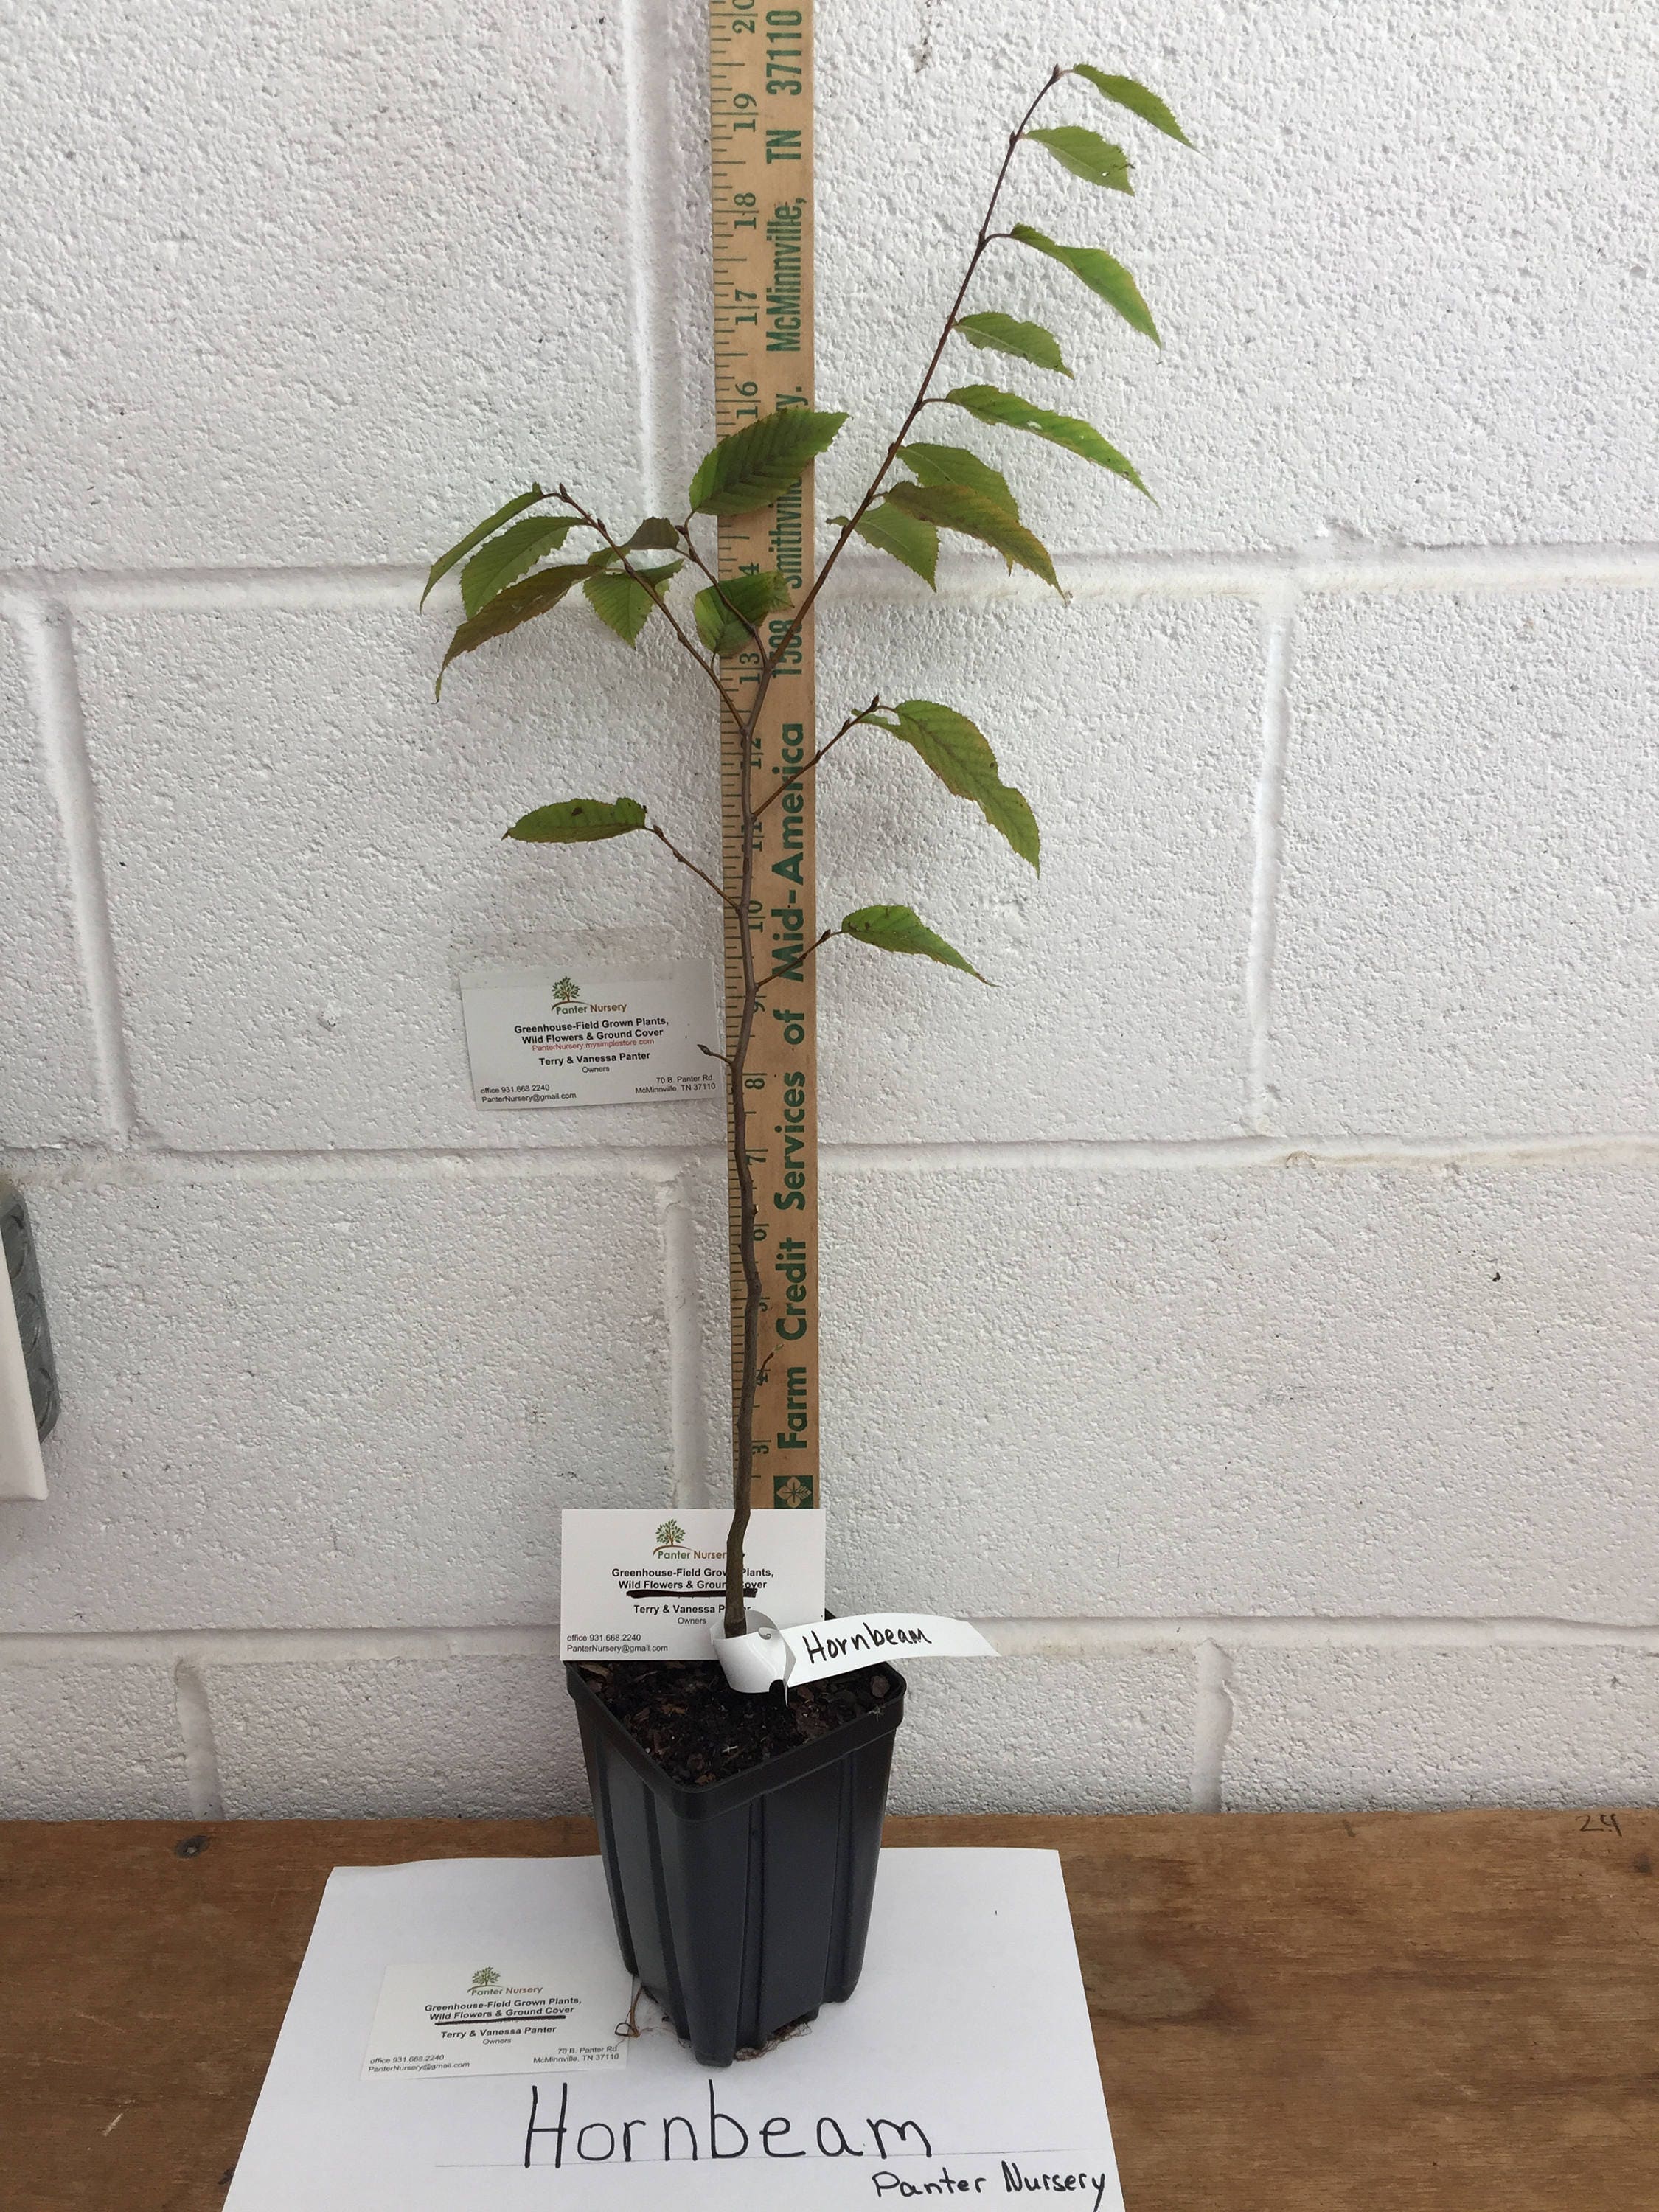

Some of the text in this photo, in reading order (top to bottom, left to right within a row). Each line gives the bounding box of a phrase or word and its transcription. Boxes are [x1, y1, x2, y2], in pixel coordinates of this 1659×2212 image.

[765, 10, 802, 95] 37110
[733, 93, 757, 133] 19
[765, 130, 801, 164] TN
[733, 192, 757, 230] 18
[765, 198, 807, 352] McMinnville,
[734, 288, 758, 326] 17
[735, 381, 758, 419] 16
[768, 619, 803, 678] 1508
[739, 652, 761, 686] 13
[556, 1004, 627, 1015] Panter Nursery
[514, 1017, 669, 1034] Greenhouse-Field Grown Plants,
[521, 1029, 664, 1045] Wild Flowers & Ground Cover
[539, 1051, 651, 1067] Terry & Vanessa Panter
[581, 1065, 611, 1074] Owners
[656, 1076, 665, 1084] 70
[677, 1075, 700, 1083] Panter
[744, 1077, 765, 1091] 8
[771, 723, 808, 1450] Farm Credit Services of Mid-America
[480, 1086, 500, 1094] office
[636, 1085, 679, 1095] McMinnville,
[693, 1082, 716, 1091] 37110
[745, 1152, 767, 1166] 7
[658, 1550, 727, 1560] Panter Nurser
[611, 1568, 701, 1578] Greenhouse-Field
[619, 1580, 768, 1590] Wild Flowers & Groun over
[633, 1604, 660, 1615] Terry
[663, 1604, 669, 1614] &
[672, 1604, 716, 1614] Vanessa
[678, 1616, 707, 1625] Owners
[567, 1644, 668, 1653] PanterNursery@gmail.com
[802, 1622, 932, 1663] Hornbeam
[471, 1986, 543, 1996] Panter Nursery
[425, 1997, 582, 2012] Greenhouse-Field Grown Plants,
[429, 2006, 574, 2021] Wild Flowers & Ground Cover
[441, 2026, 557, 2039] Terry & Vanessa Panter
[482, 2037, 512, 2045] Owners
[370, 2056, 391, 2065] office
[595, 2053, 619, 2061] 37110
[524, 2079, 933, 2168] Hornbeam
[872, 2160, 1106, 2212] Panter Nursery
